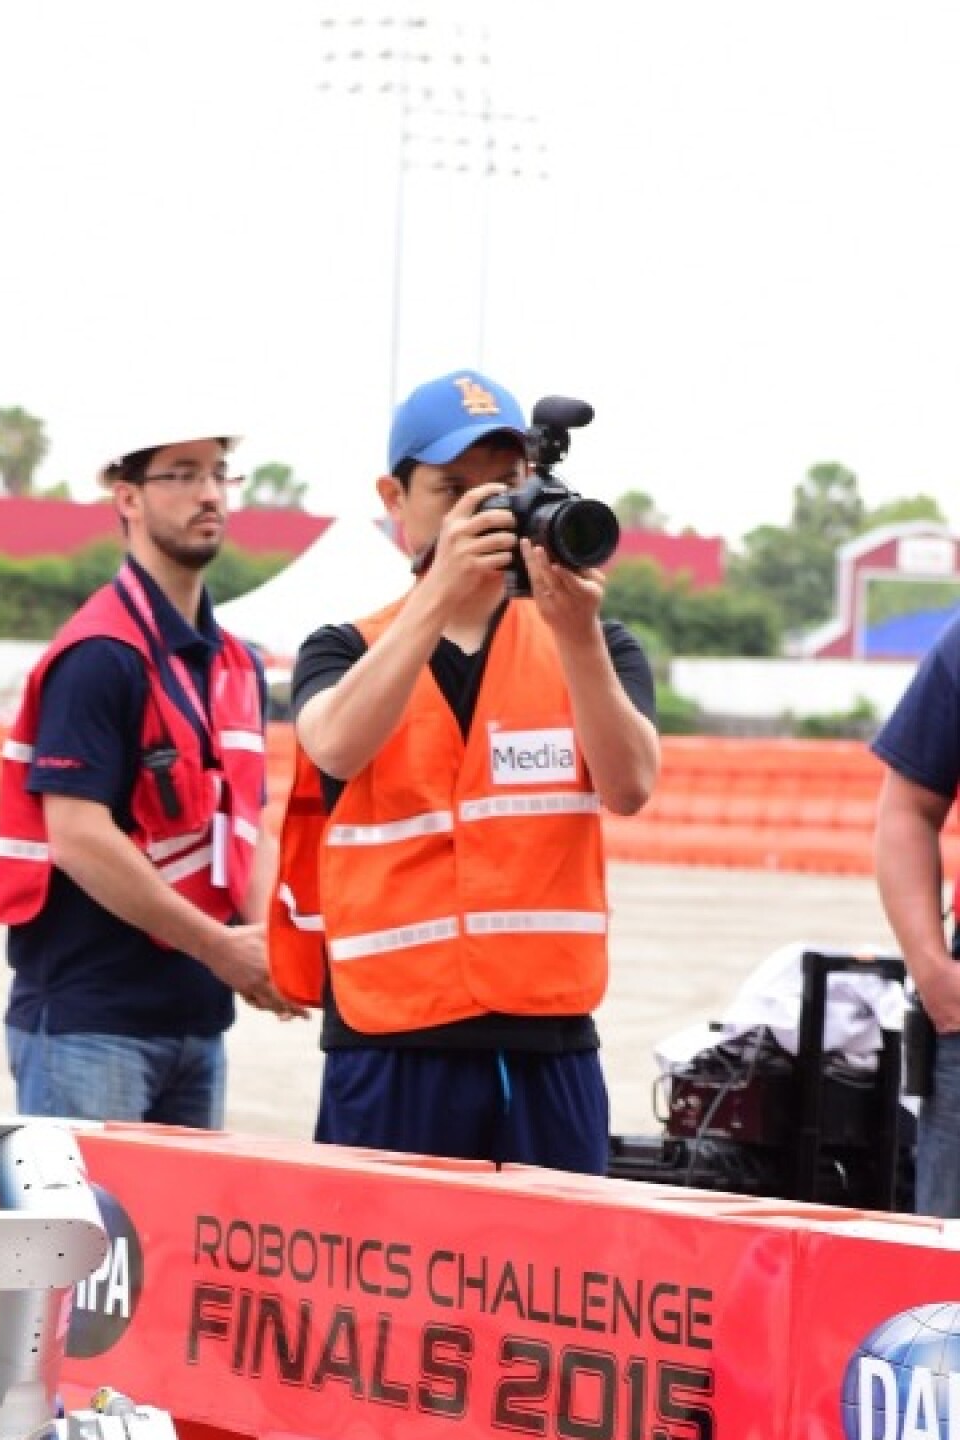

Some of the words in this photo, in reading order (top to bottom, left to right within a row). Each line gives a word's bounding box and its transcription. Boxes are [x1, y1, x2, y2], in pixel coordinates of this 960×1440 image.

[492, 745, 574, 771] Media
[186, 1279, 473, 1421] FINALS
[194, 1215, 410, 1300] ROBOTICS
[427, 1249, 713, 1351] CHALLENGE
